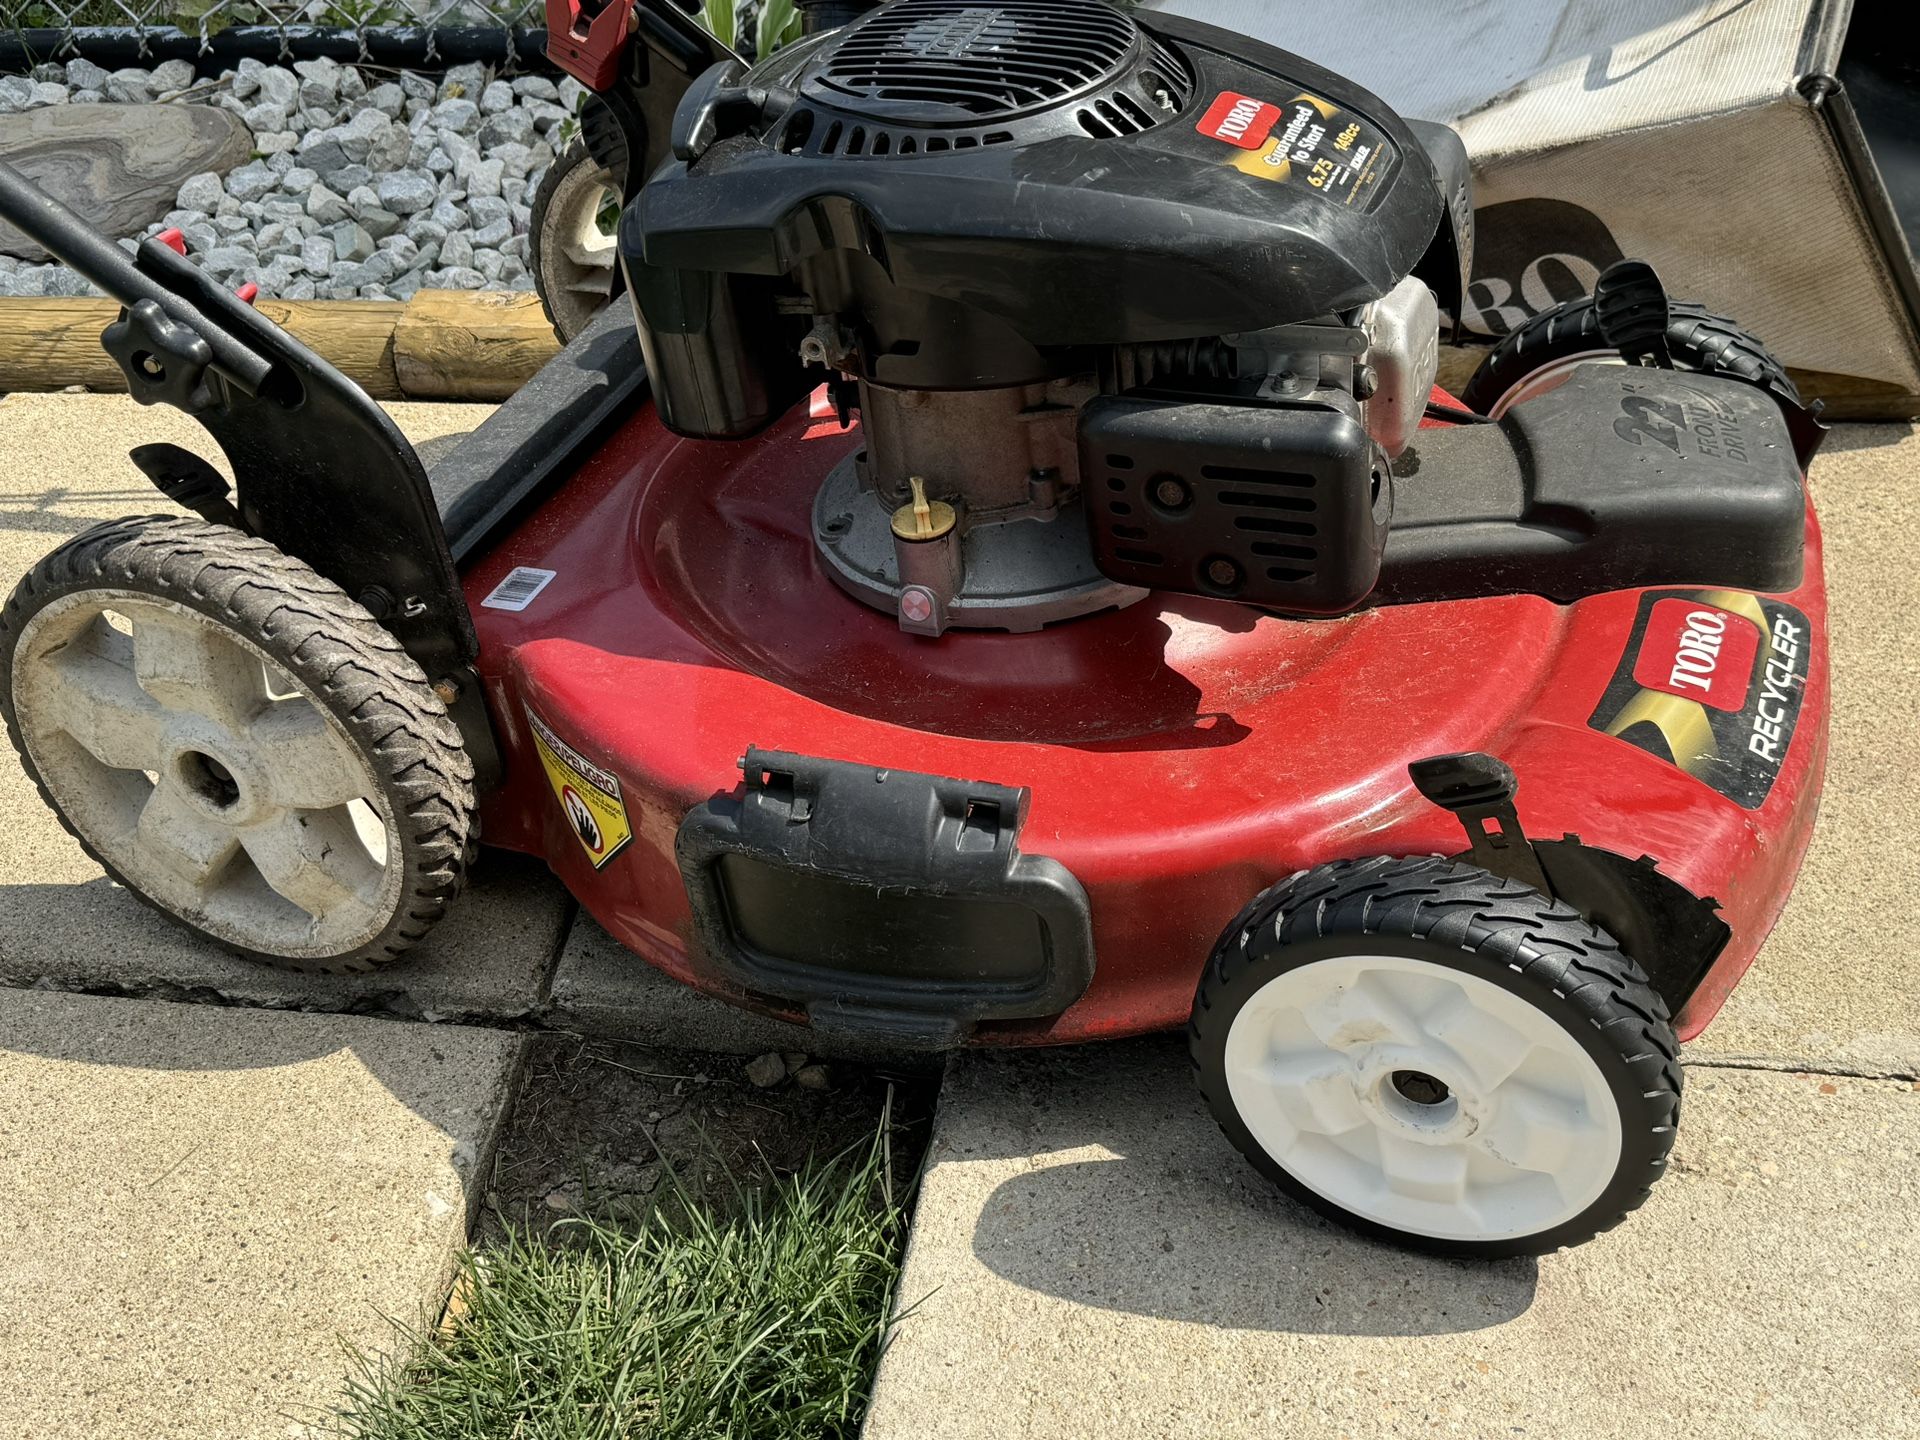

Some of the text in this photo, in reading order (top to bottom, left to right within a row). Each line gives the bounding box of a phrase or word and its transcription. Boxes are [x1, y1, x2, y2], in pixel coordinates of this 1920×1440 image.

[1215, 98, 1260, 141] TORO
[1263, 105, 1314, 167] Guaranteed
[1290, 123, 1326, 163] to Start
[1307, 157, 1334, 188] 6.75
[1333, 123, 1361, 151] 149cc
[1688, 403, 1722, 458] FRONT
[1716, 413, 1749, 464] DRIVE
[1669, 611, 1726, 692] TORO
[1748, 618, 1801, 763] RECYCLER
